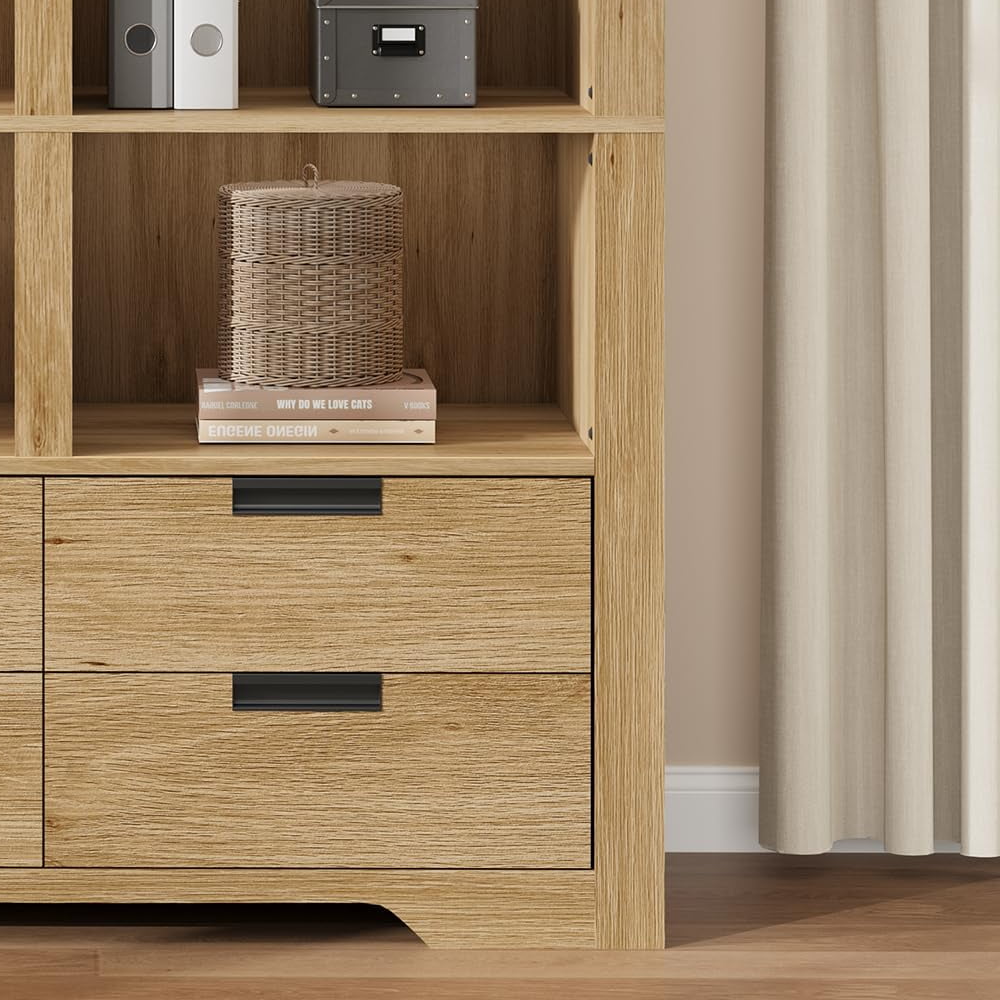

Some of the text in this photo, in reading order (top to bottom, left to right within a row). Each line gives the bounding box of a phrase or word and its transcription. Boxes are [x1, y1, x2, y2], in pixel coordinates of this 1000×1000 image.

[276, 399, 373, 409] WHY DO WE LOVE CATS
